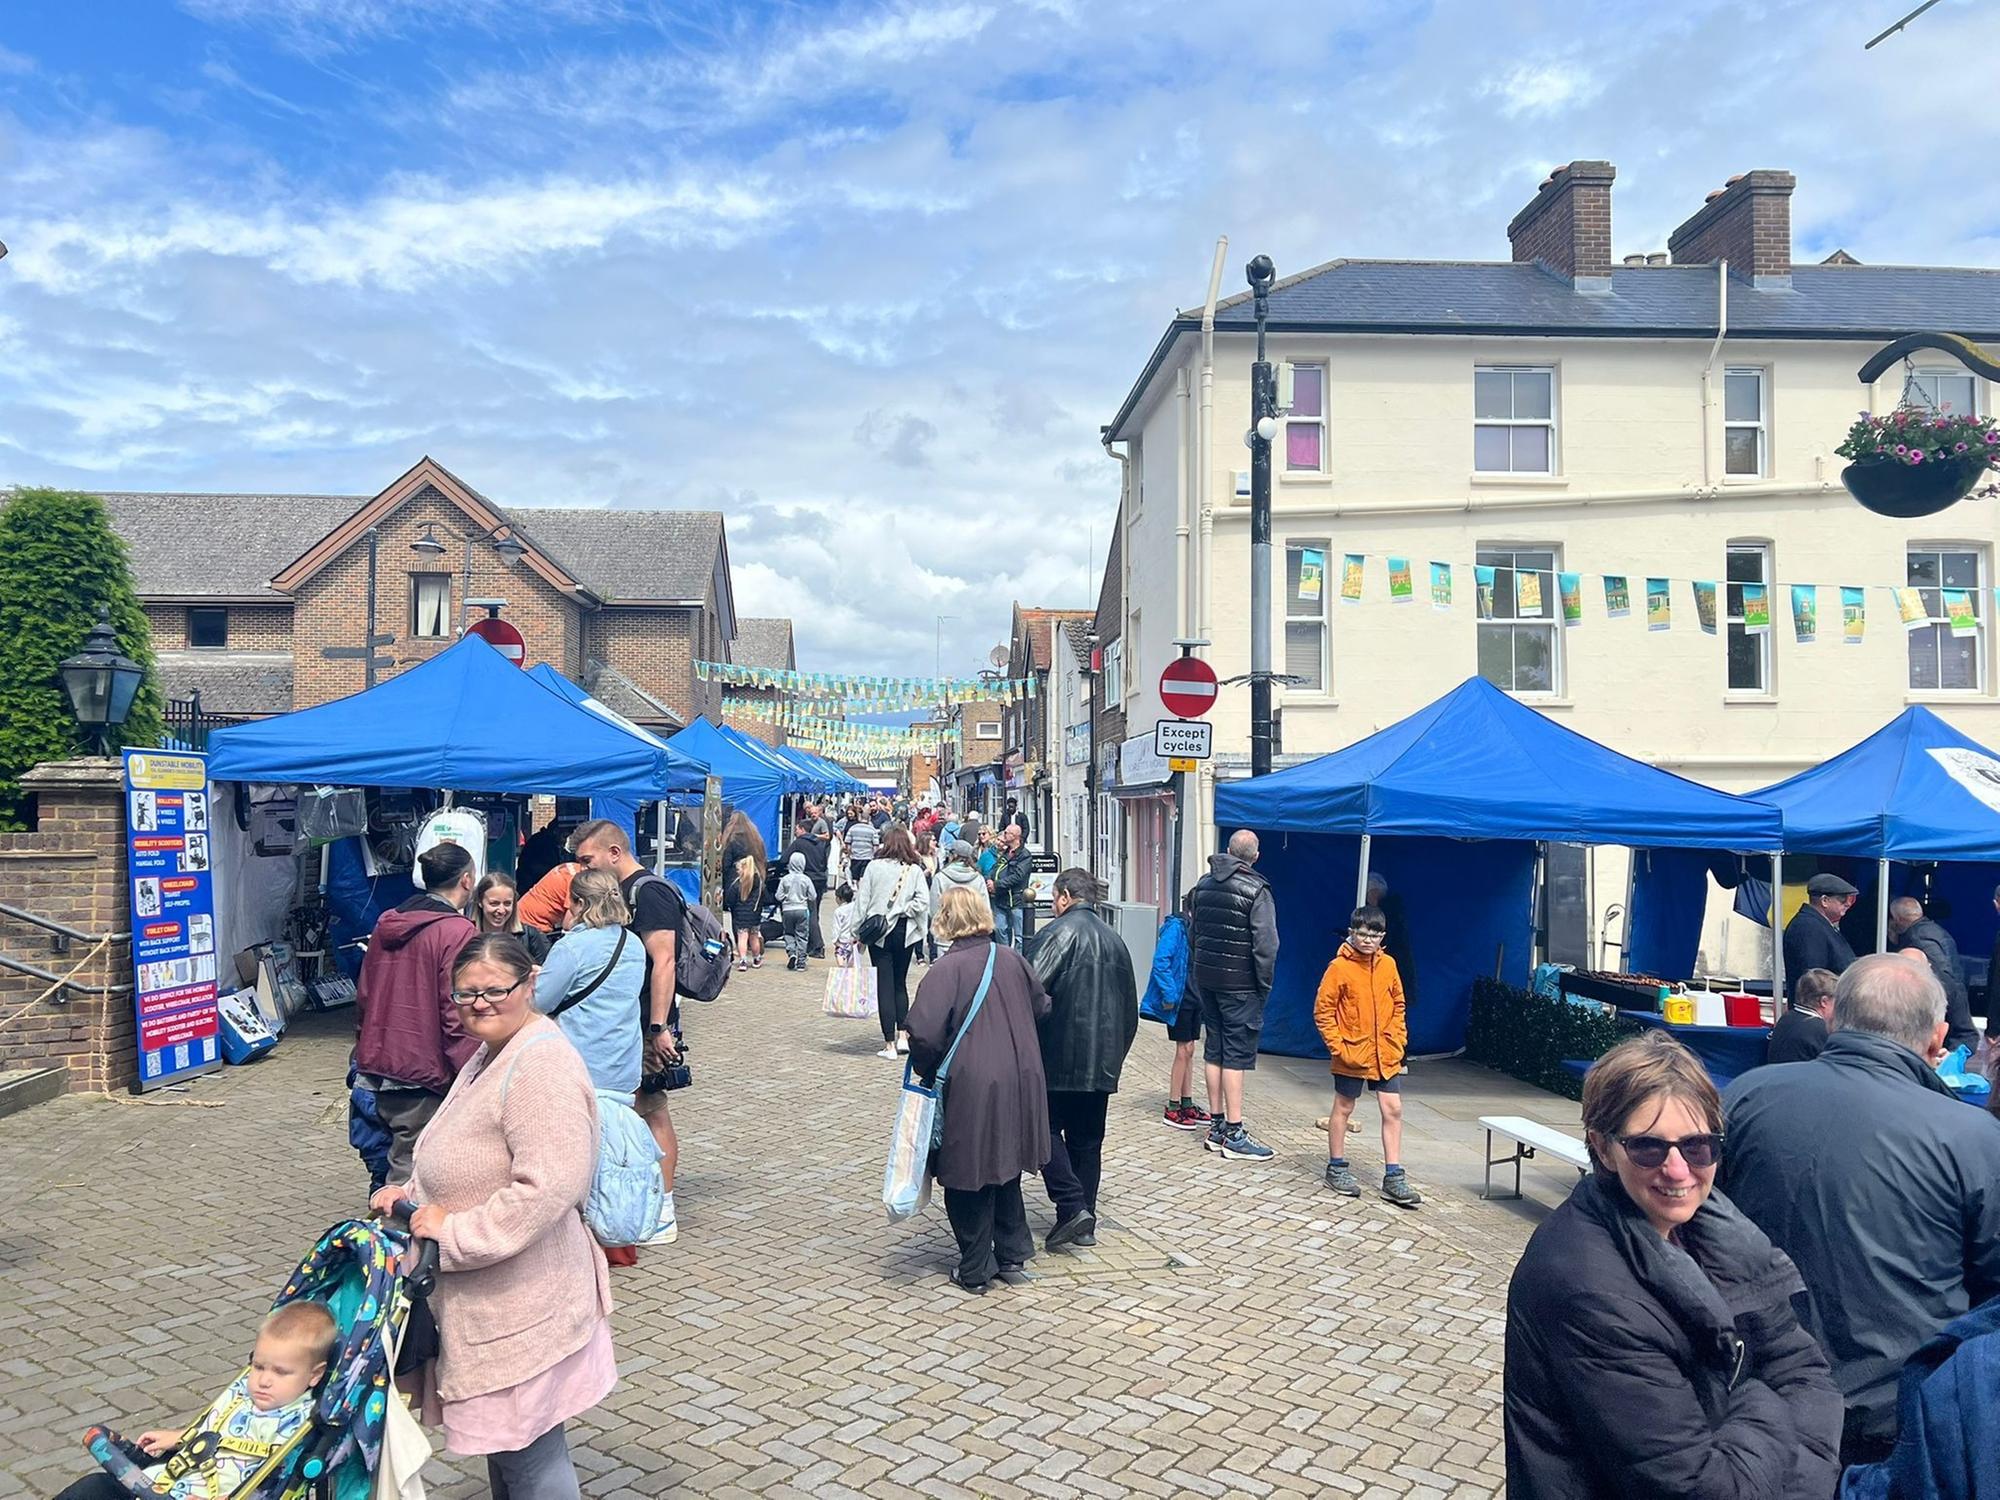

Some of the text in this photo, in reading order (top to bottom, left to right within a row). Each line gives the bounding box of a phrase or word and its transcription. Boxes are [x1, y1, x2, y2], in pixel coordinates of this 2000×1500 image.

[1162, 726, 1205, 740] Except
[1163, 741, 1202, 752] cycles
[150, 760, 204, 769] DUNSTABLE MOBILITY
[163, 936, 181, 944] SUPPORT
[159, 947, 172, 955] BACK
[172, 944, 189, 952] SUPPORT
